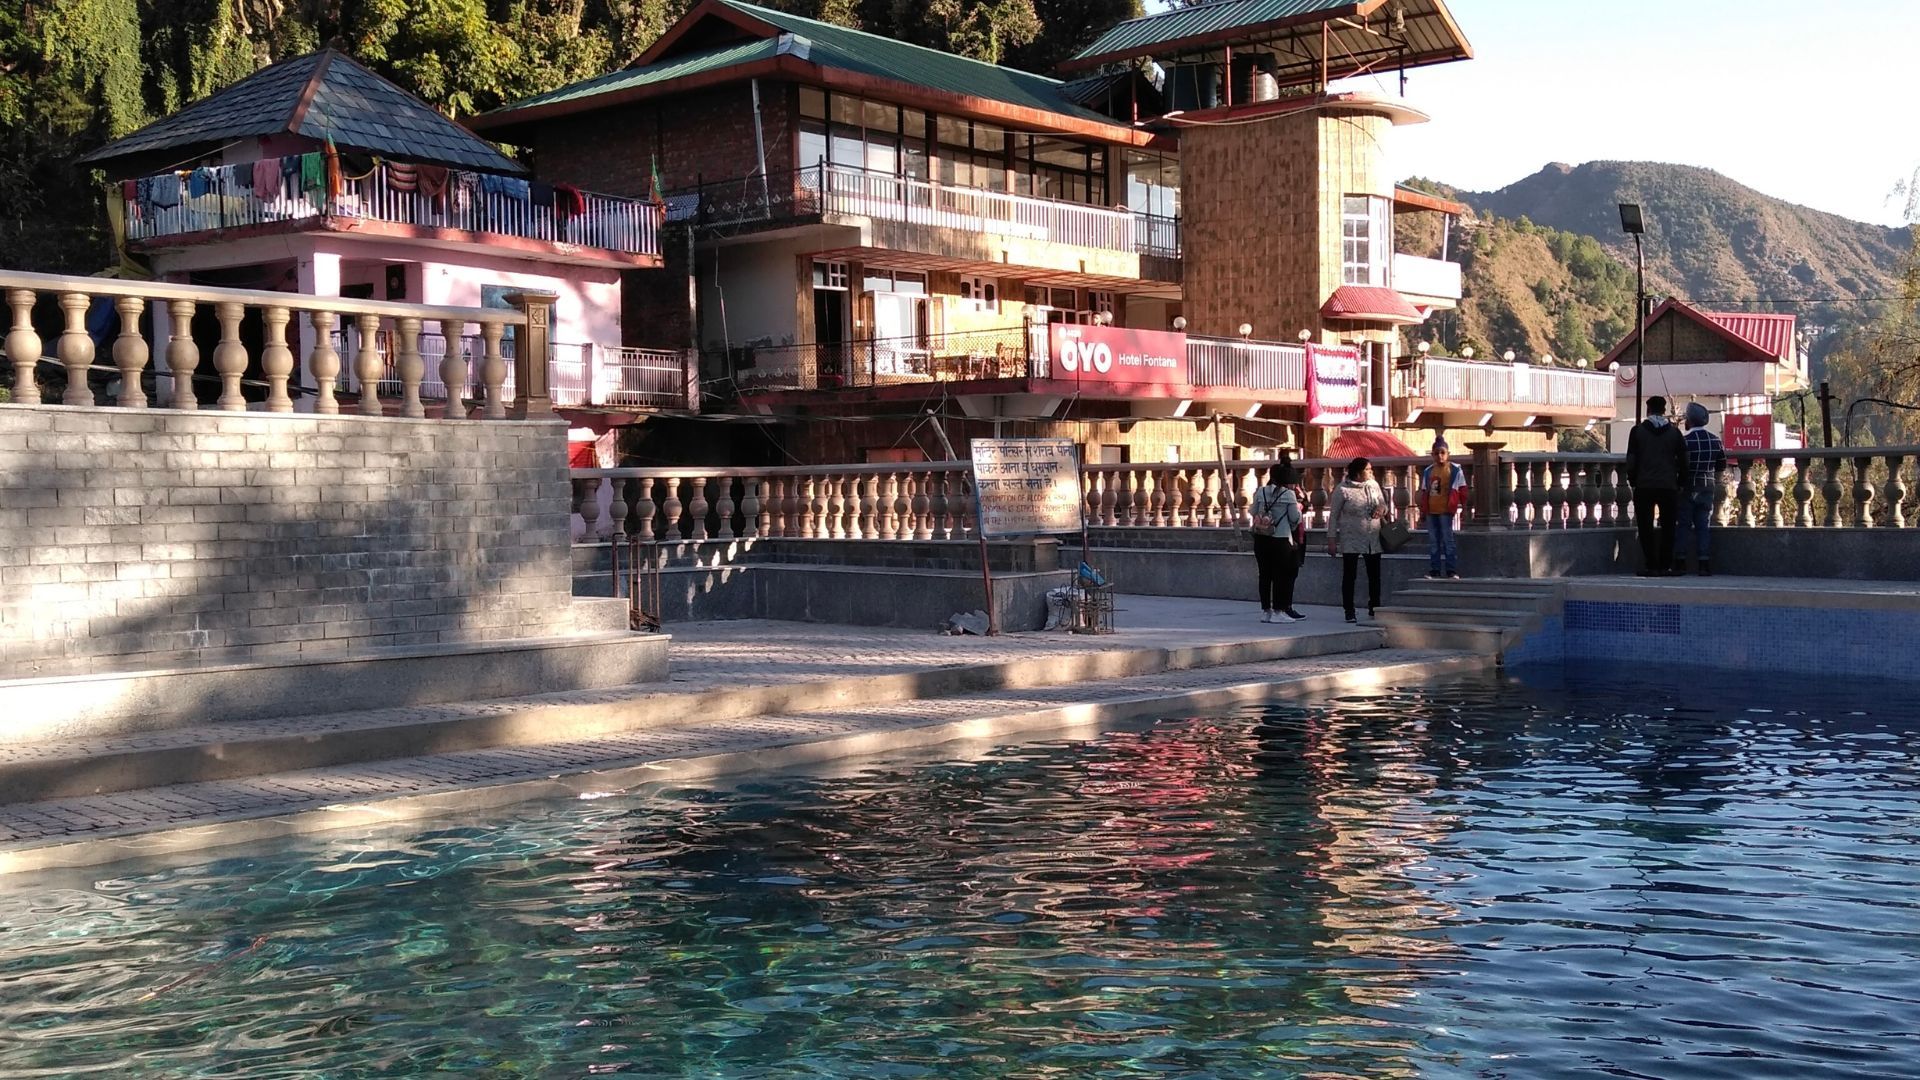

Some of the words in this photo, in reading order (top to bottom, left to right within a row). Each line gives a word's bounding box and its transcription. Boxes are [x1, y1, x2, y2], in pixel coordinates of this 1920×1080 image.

[1060, 340, 1113, 373] OYO
[1119, 353, 1142, 367] Hotel
[1143, 354, 1177, 368] Fontana
[1733, 427, 1763, 435] HOTEL
[1733, 436, 1762, 450] Anuj
[1000, 462, 1020, 475] आना
